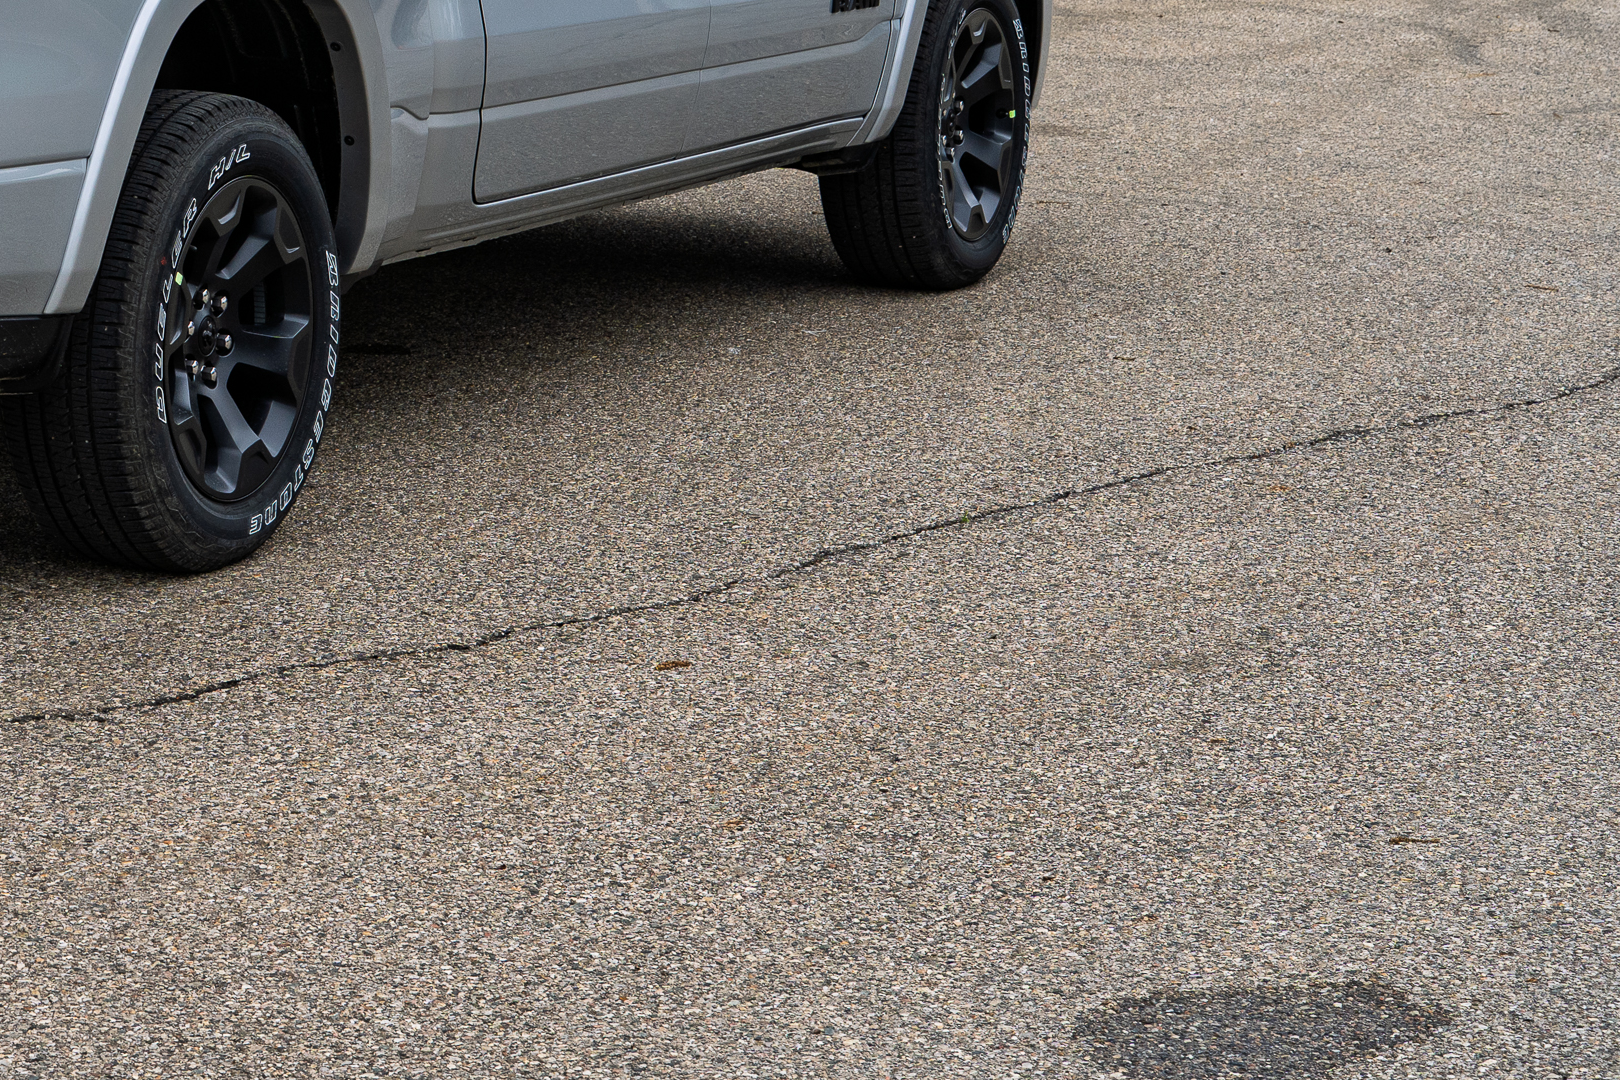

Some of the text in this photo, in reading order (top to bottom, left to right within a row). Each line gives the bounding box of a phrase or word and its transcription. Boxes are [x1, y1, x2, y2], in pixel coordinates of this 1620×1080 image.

[207, 143, 251, 191] H/L
[154, 197, 198, 424] DUELER
[248, 249, 341, 535] BRIDGESTONE
